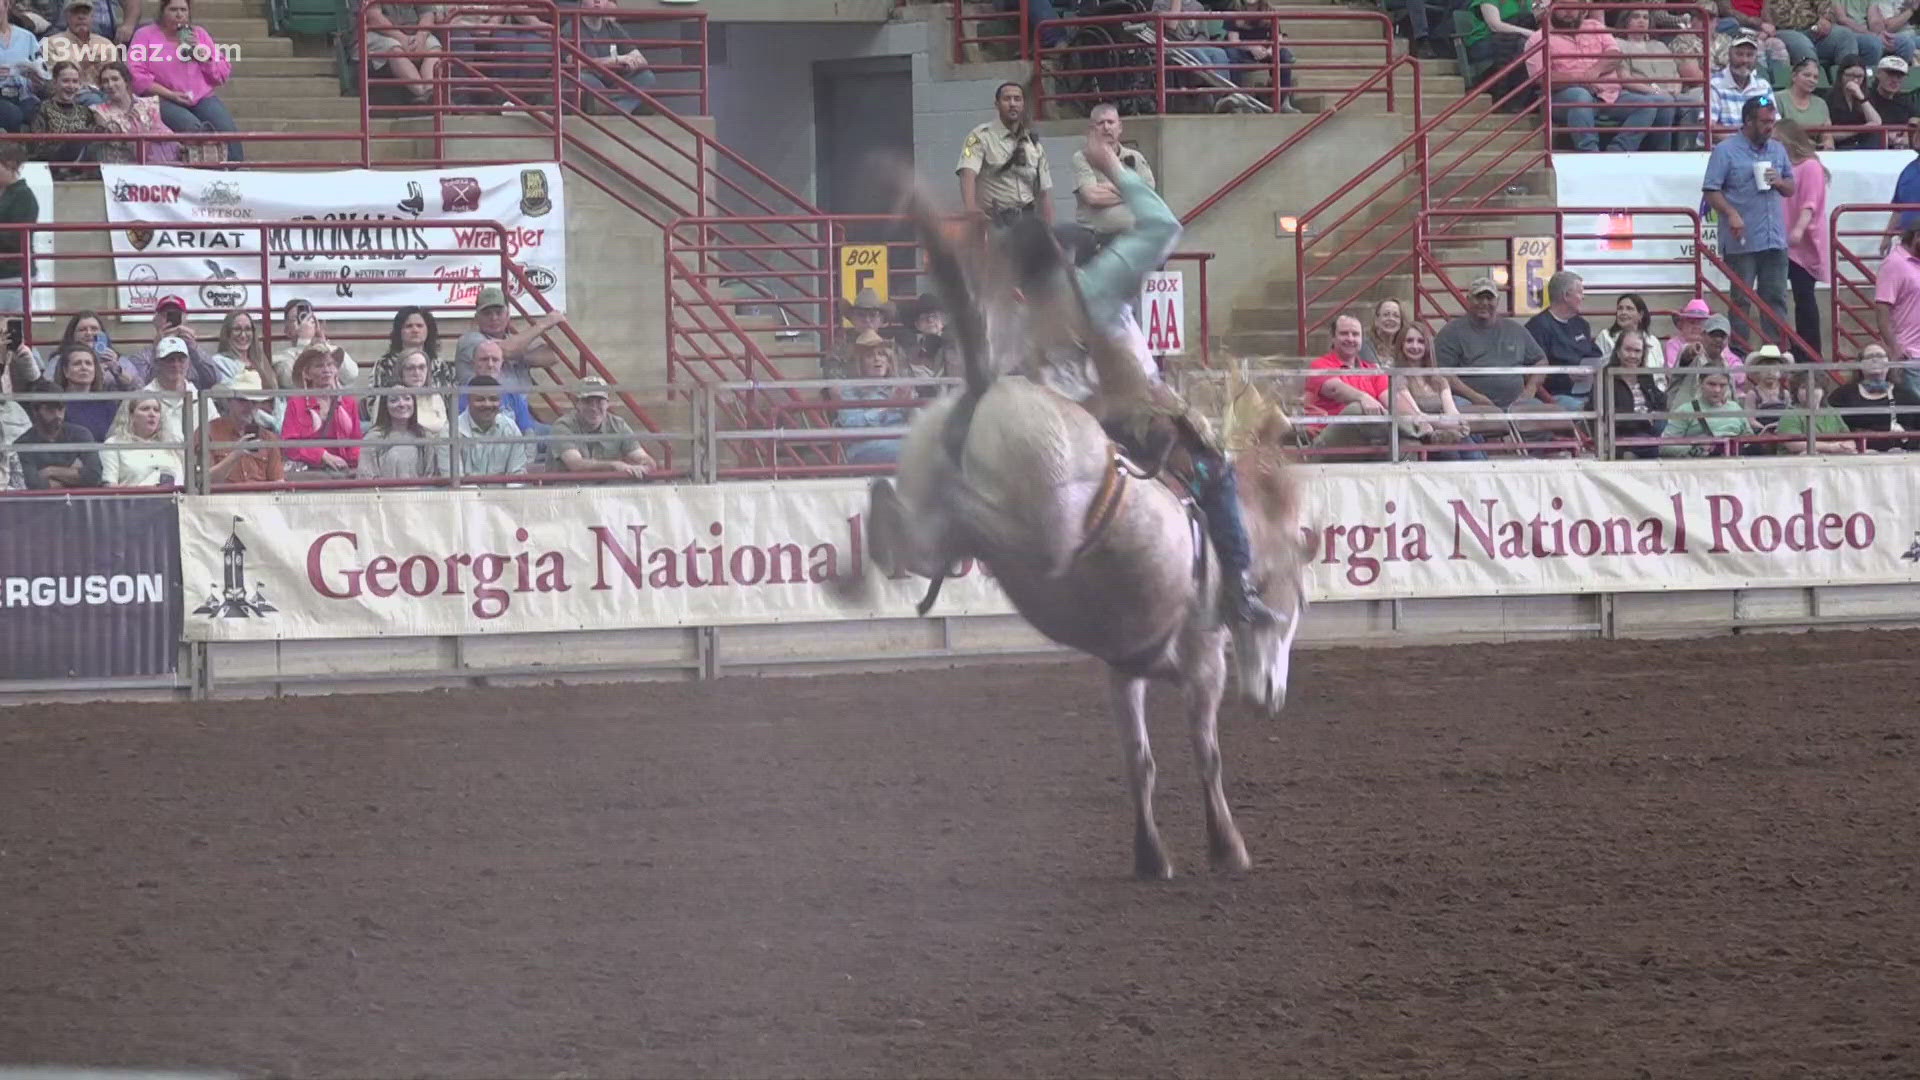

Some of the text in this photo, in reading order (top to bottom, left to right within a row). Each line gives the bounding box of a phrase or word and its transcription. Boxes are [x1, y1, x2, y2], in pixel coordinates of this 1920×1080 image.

[128, 184, 181, 203] ROCKY
[192, 207, 252, 218] STETSON
[156, 231, 245, 249] ARIAT
[452, 226, 544, 257] Wrangler
[1518, 240, 1551, 256] BOX
[846, 249, 881, 266] BOX
[1146, 279, 1178, 292] BOX
[1147, 298, 1181, 350] AA
[1448, 492, 1689, 560] National
[1705, 487, 1876, 553] Rodeo
[307, 513, 865, 619] Georgia National
[0, 573, 163, 608] RGUSON
